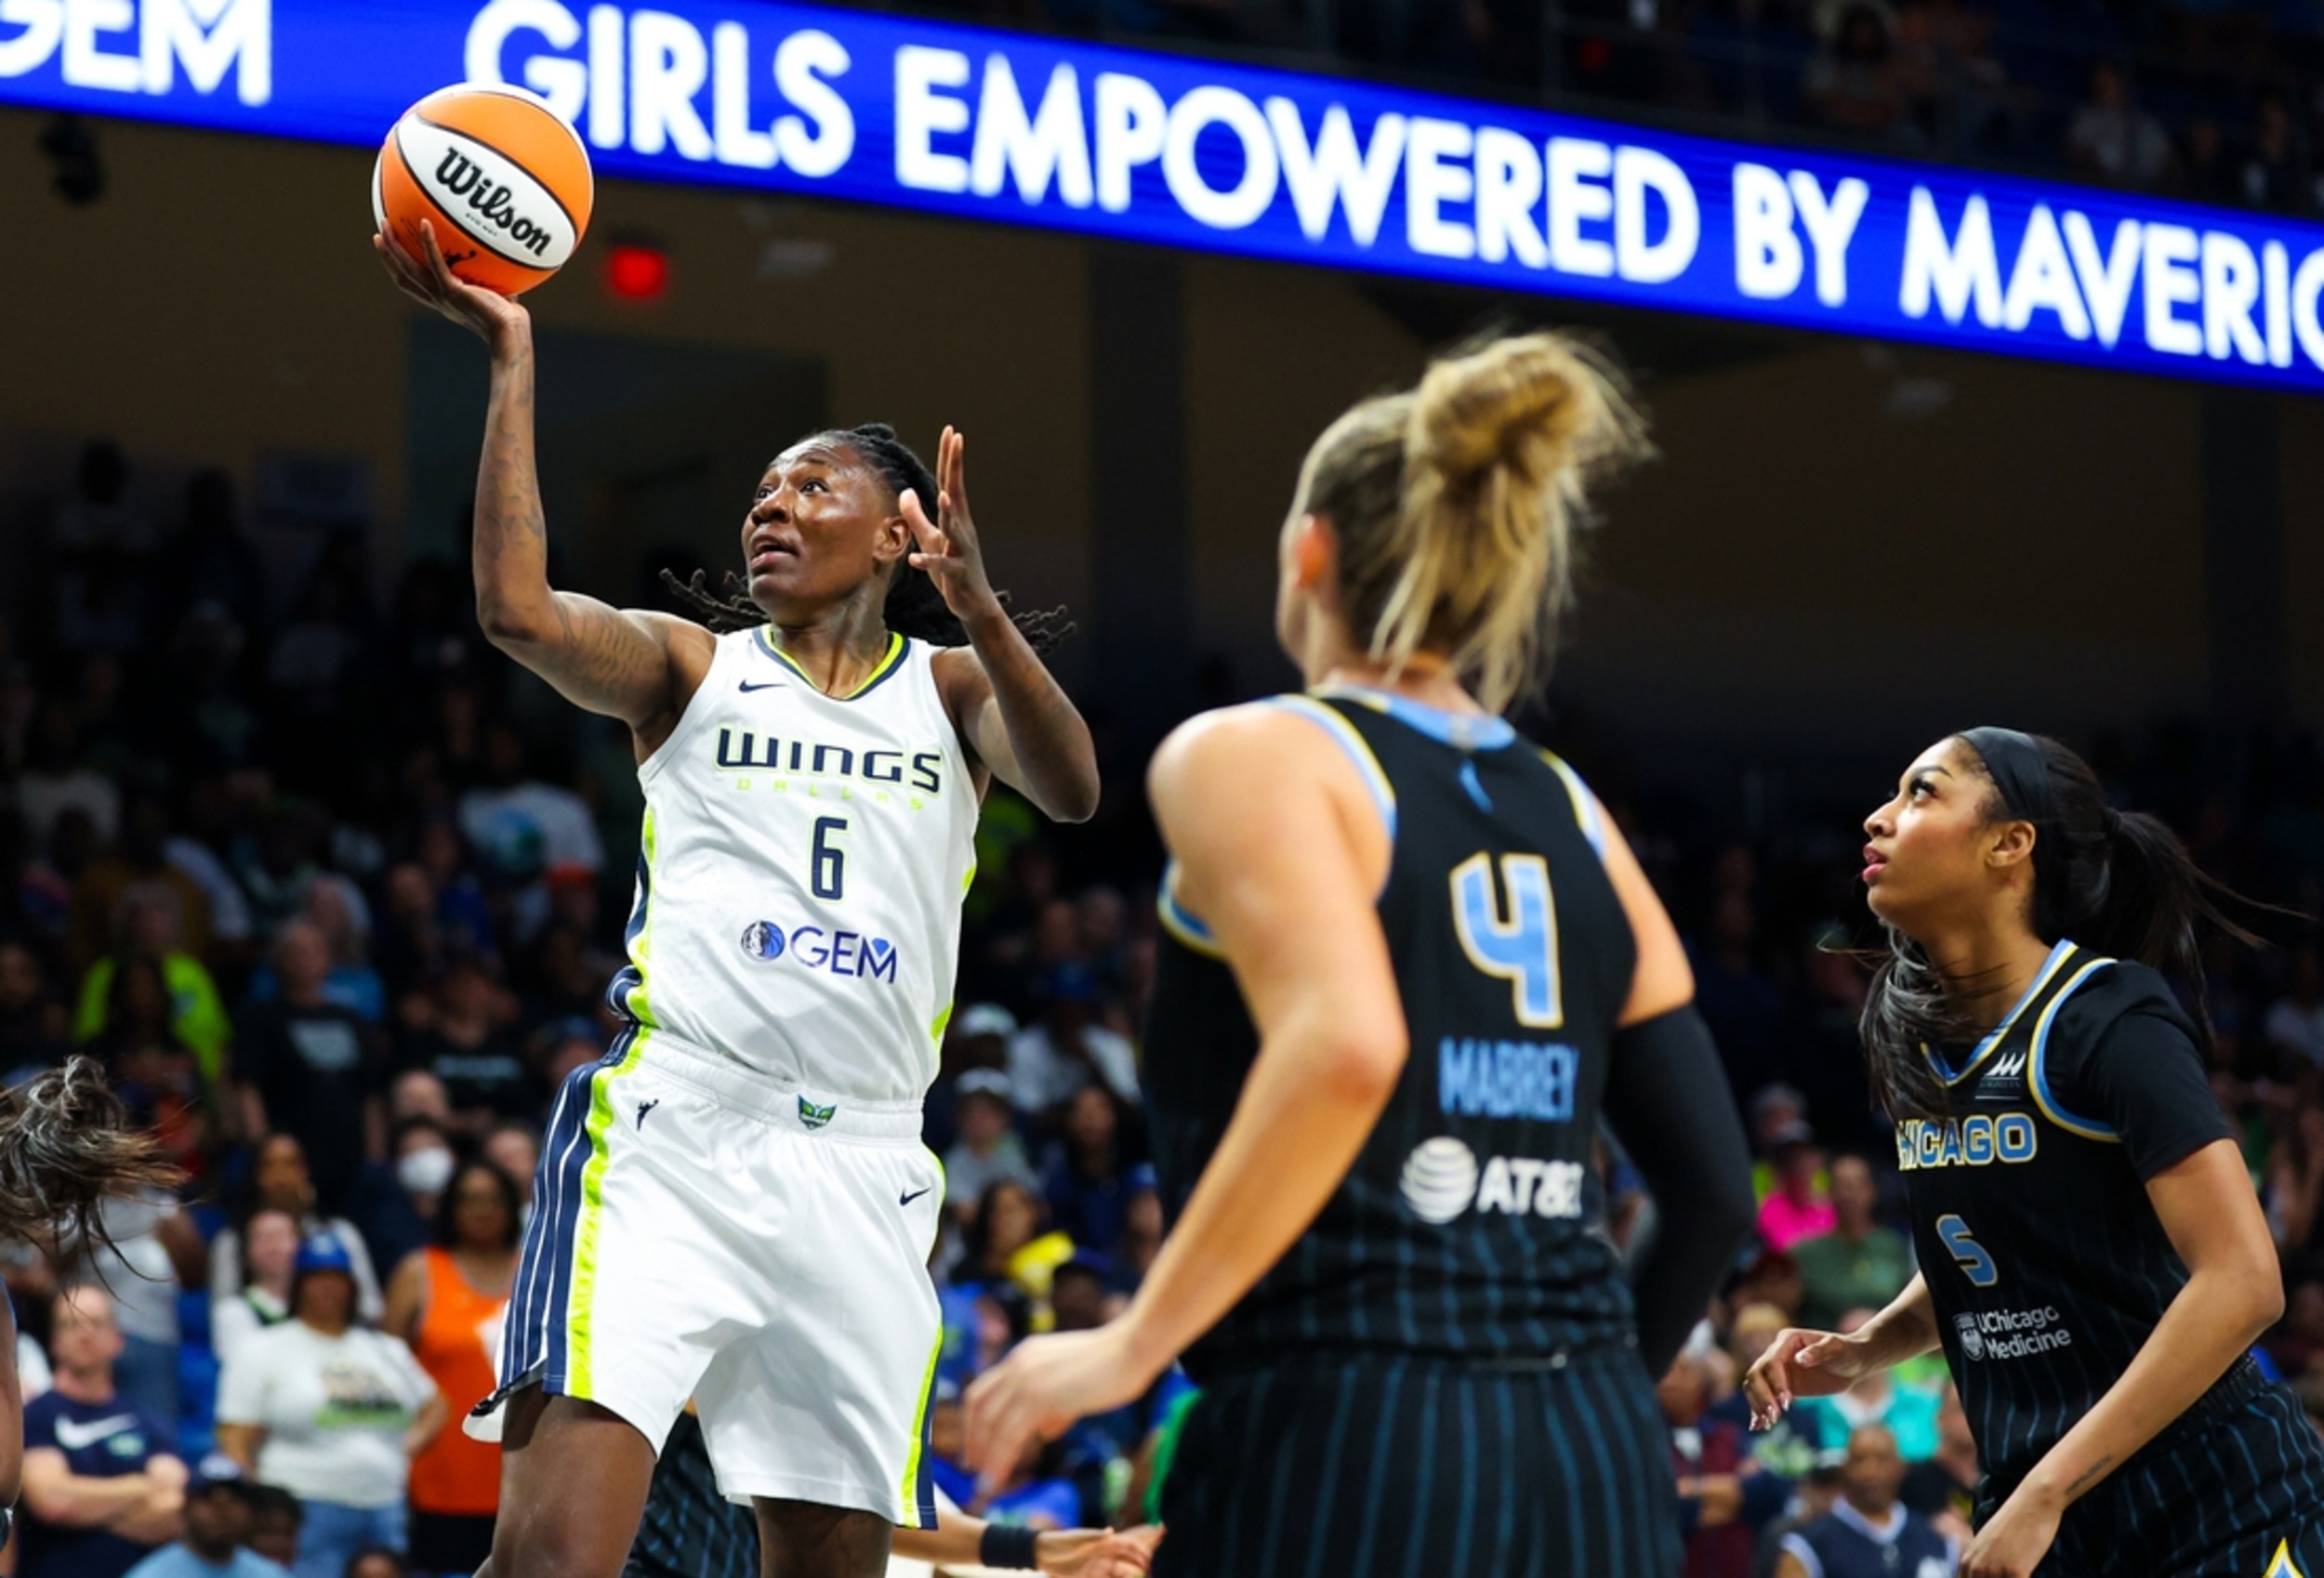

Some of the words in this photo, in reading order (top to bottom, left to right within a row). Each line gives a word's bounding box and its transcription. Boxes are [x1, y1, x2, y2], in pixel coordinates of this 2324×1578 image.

[465, 0, 855, 178] GIRLS
[894, 44, 1701, 284] EMPOWERED
[1732, 162, 1870, 309] BY
[435, 144, 552, 258] Wilson
[715, 727, 943, 795] WINGS
[810, 814, 849, 901] 6
[790, 926, 898, 985] GEM
[1448, 849, 1565, 1031] 4
[1439, 1035, 1580, 1124] MABREY
[1934, 1213, 1999, 1288] 5
[1974, 1305, 2060, 1334] UChicago
[1985, 1328, 2072, 1360] Medicine
